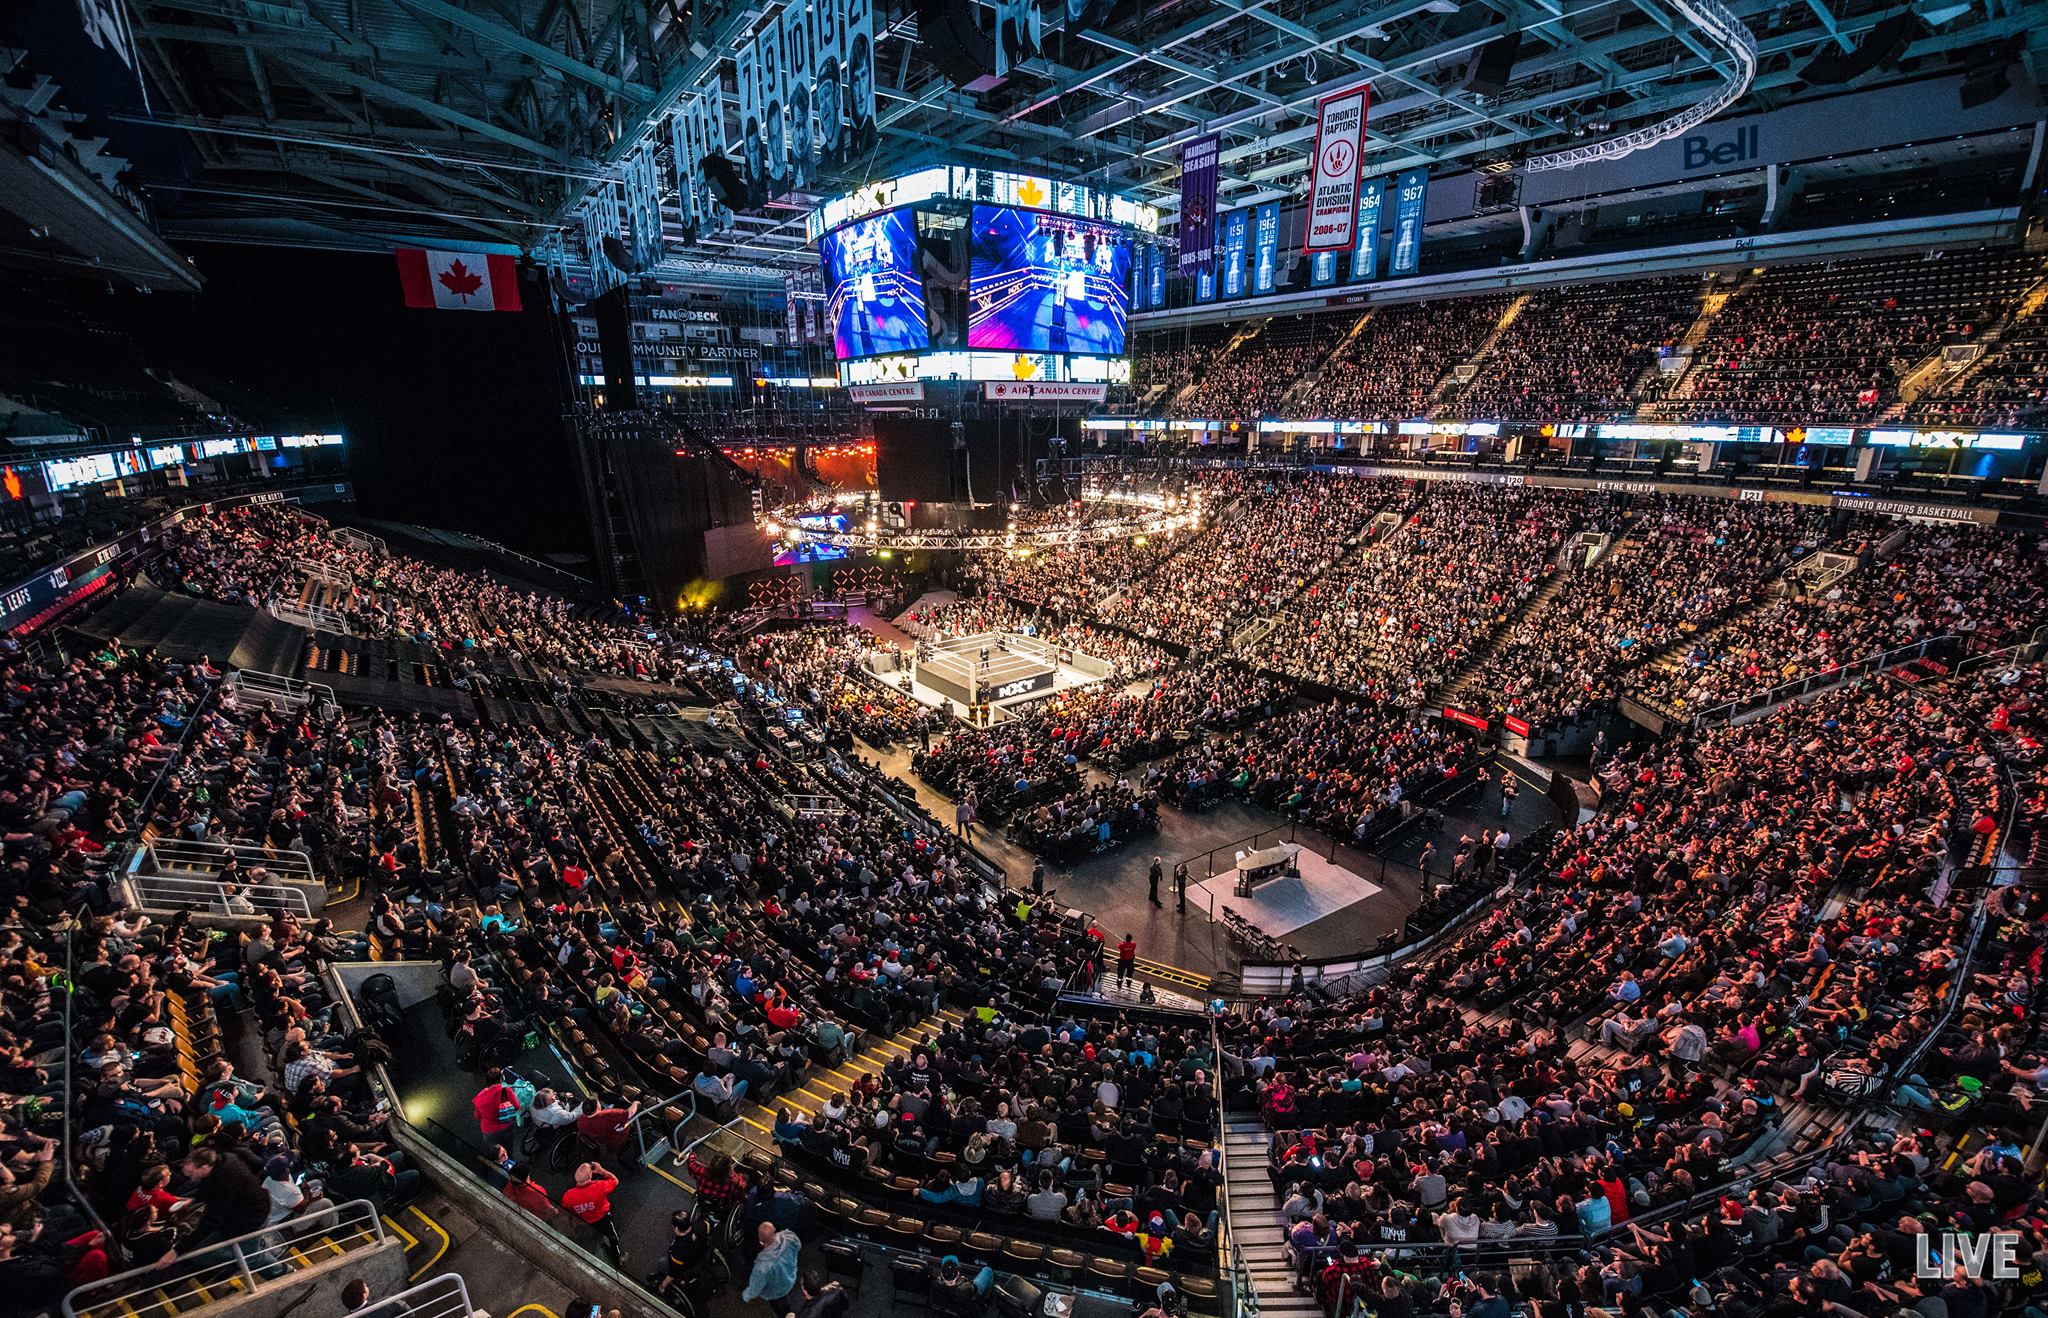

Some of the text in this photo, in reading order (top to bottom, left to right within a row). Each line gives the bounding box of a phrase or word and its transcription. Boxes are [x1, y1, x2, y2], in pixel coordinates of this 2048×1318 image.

[788, 22, 805, 79] 10
[765, 46, 775, 93] 9
[742, 64, 751, 110] 7
[710, 97, 720, 134] 5
[1327, 107, 1359, 124] TORONTO
[695, 113, 702, 151] 4
[1324, 119, 1358, 136] RAPTORS
[1184, 139, 1217, 160] INAUGURAL
[1684, 125, 1759, 170] Bell
[1184, 155, 1216, 174] SEASON
[1318, 182, 1353, 197] ATLANTIC
[1401, 185, 1423, 202] 1967
[847, 180, 898, 221] NXT
[1317, 194, 1352, 208] DIVISION
[1360, 194, 1380, 210] 1964
[1316, 206, 1350, 217] CHAMPIONS
[1313, 223, 1348, 236] 2006-07
[1735, 238, 1755, 249] Bell
[1497, 266, 1530, 275] raptors.com
[652, 308, 677, 320] FAN
[688, 311, 719, 322] DECK
[633, 343, 695, 357] MMUNITY
[701, 347, 758, 358] PARTNER
[871, 356, 919, 381] NXT
[857, 387, 915, 398] AIR CANADA CENTRE
[1011, 386, 1100, 396] AIR CANADA CENTRE
[1911, 431, 1980, 448] NXT
[1413, 470, 1437, 479] MAPLE
[1442, 472, 1467, 481] LEAFS
[1508, 476, 1523, 485] 120
[1608, 482, 1624, 491] THE
[1626, 483, 1656, 493] NORTH
[1743, 491, 1761, 500] 121
[1838, 498, 1974, 521] TORONTO RAPTORS BASKETBALL
[6, 587, 32, 612] LEAFS
[999, 679, 1036, 698] NXT
[574, 1201, 596, 1214] EMS
